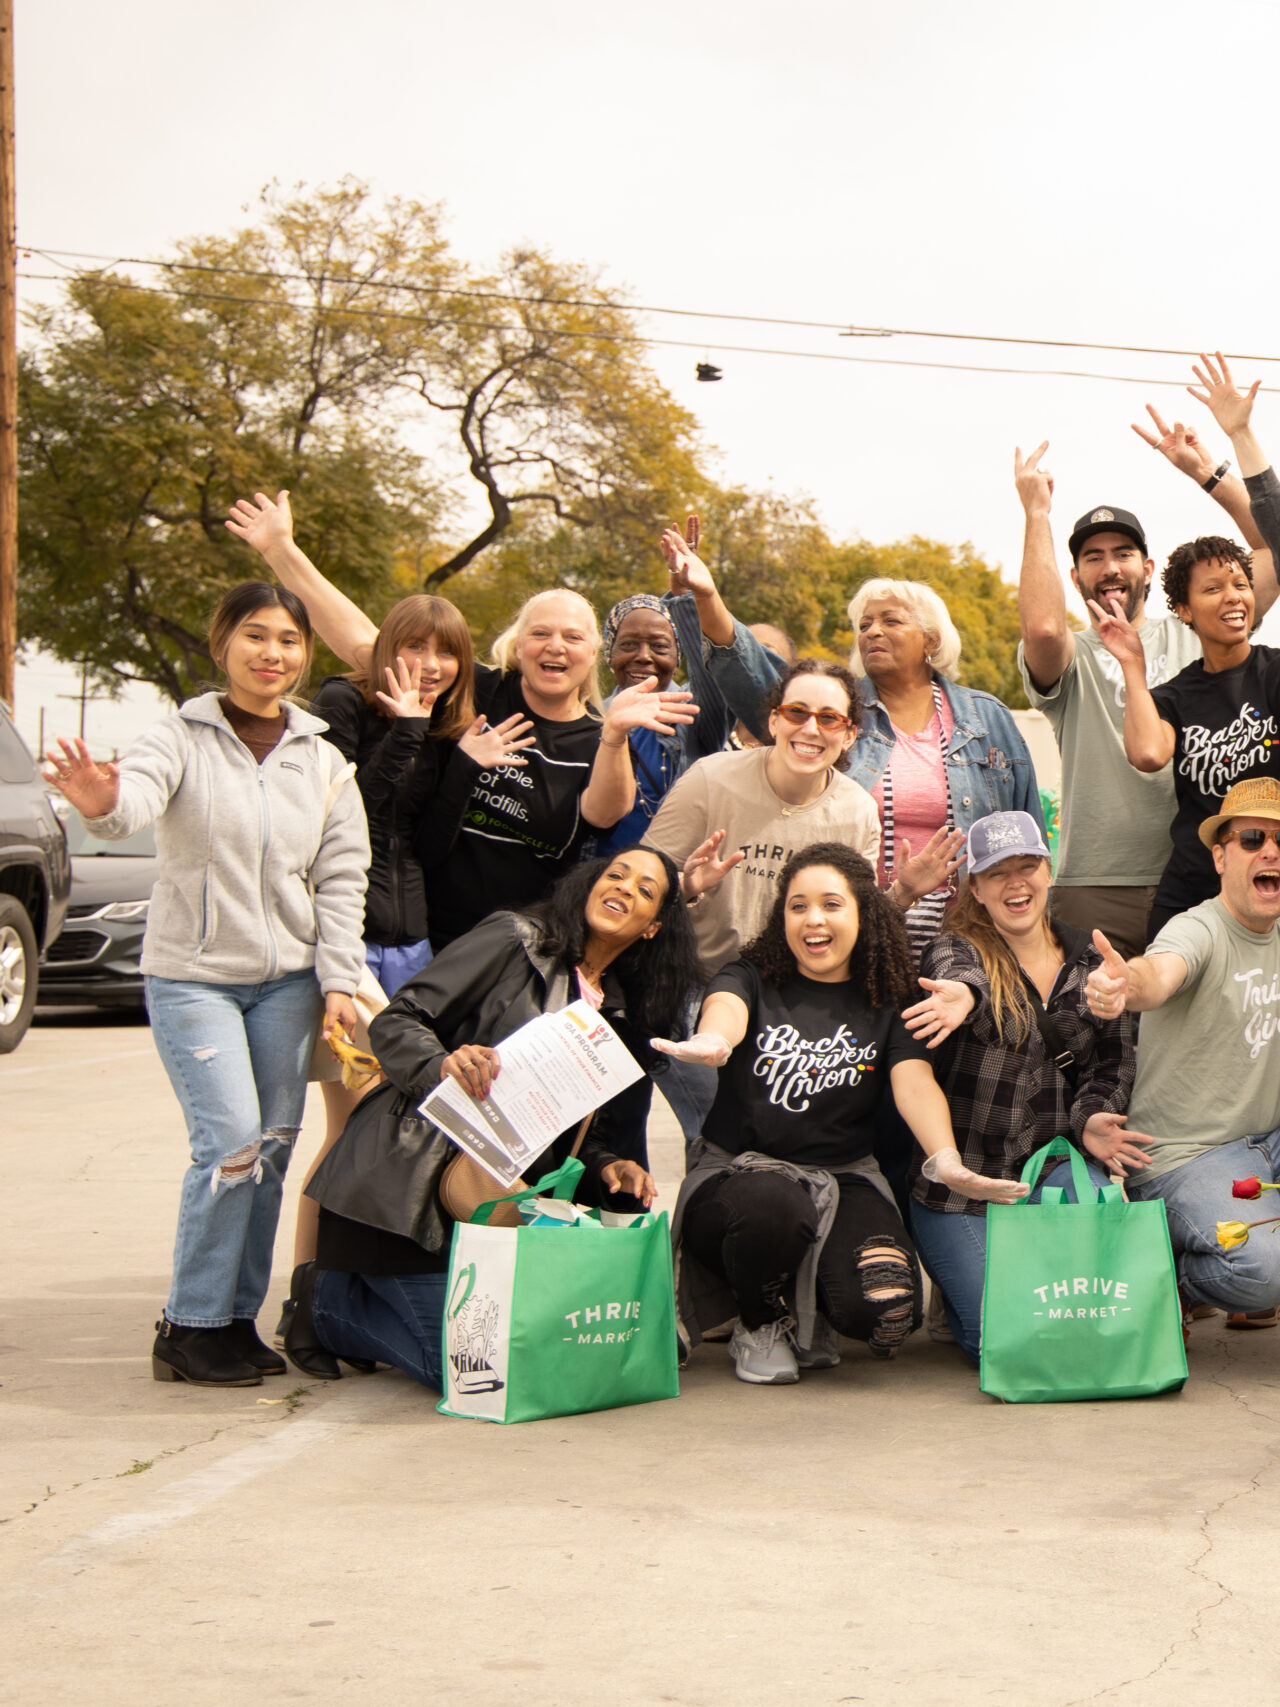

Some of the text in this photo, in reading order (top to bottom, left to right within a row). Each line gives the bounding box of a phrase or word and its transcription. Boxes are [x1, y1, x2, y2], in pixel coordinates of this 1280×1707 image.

[1181, 701, 1260, 755] Black
[1178, 715, 1278, 782] Thriver
[479, 772, 501, 788] ot
[1198, 744, 1271, 798] Union
[739, 843, 795, 863] THRI
[575, 1034, 608, 1076] PROGRAM
[756, 1024, 857, 1054] Black
[753, 1041, 877, 1085] Thriver
[769, 1066, 862, 1112] Union
[1033, 1277, 1129, 1303] THRIVE
[564, 1301, 641, 1329] THRIE
[1048, 1305, 1118, 1319] MARKET
